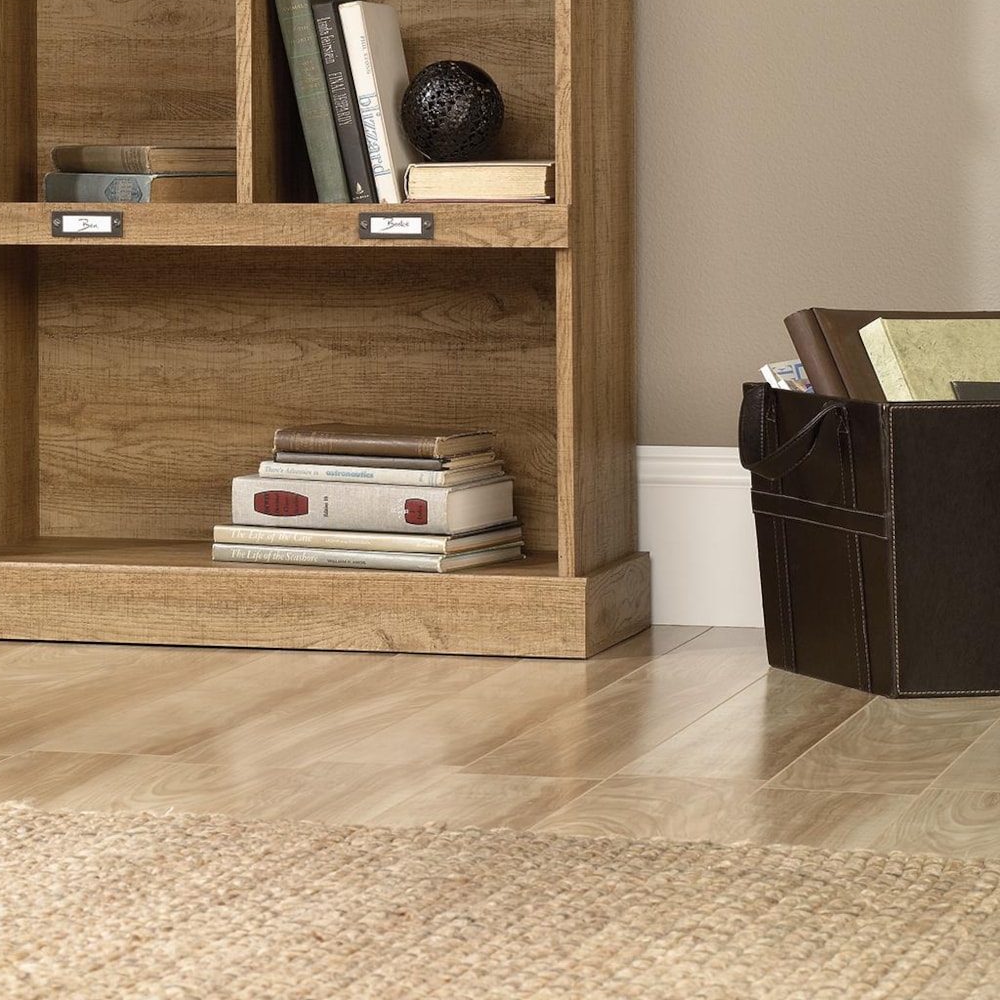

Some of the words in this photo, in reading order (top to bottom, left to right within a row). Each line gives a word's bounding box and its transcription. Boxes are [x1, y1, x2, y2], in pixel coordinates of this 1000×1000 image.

[329, 72, 346, 93] FINAL
[333, 90, 352, 127] JEOPARDY
[358, 93, 391, 177] blizzard
[326, 470, 374, 479] astronautics
[231, 530, 244, 538] The
[248, 530, 265, 542] Life
[267, 532, 276, 543] of
[278, 533, 291, 541] the
[230, 549, 245, 559] The
[246, 549, 262, 561] Life
[263, 550, 272, 562] of
[272, 550, 285, 561] the
[286, 552, 319, 562] Seashore
